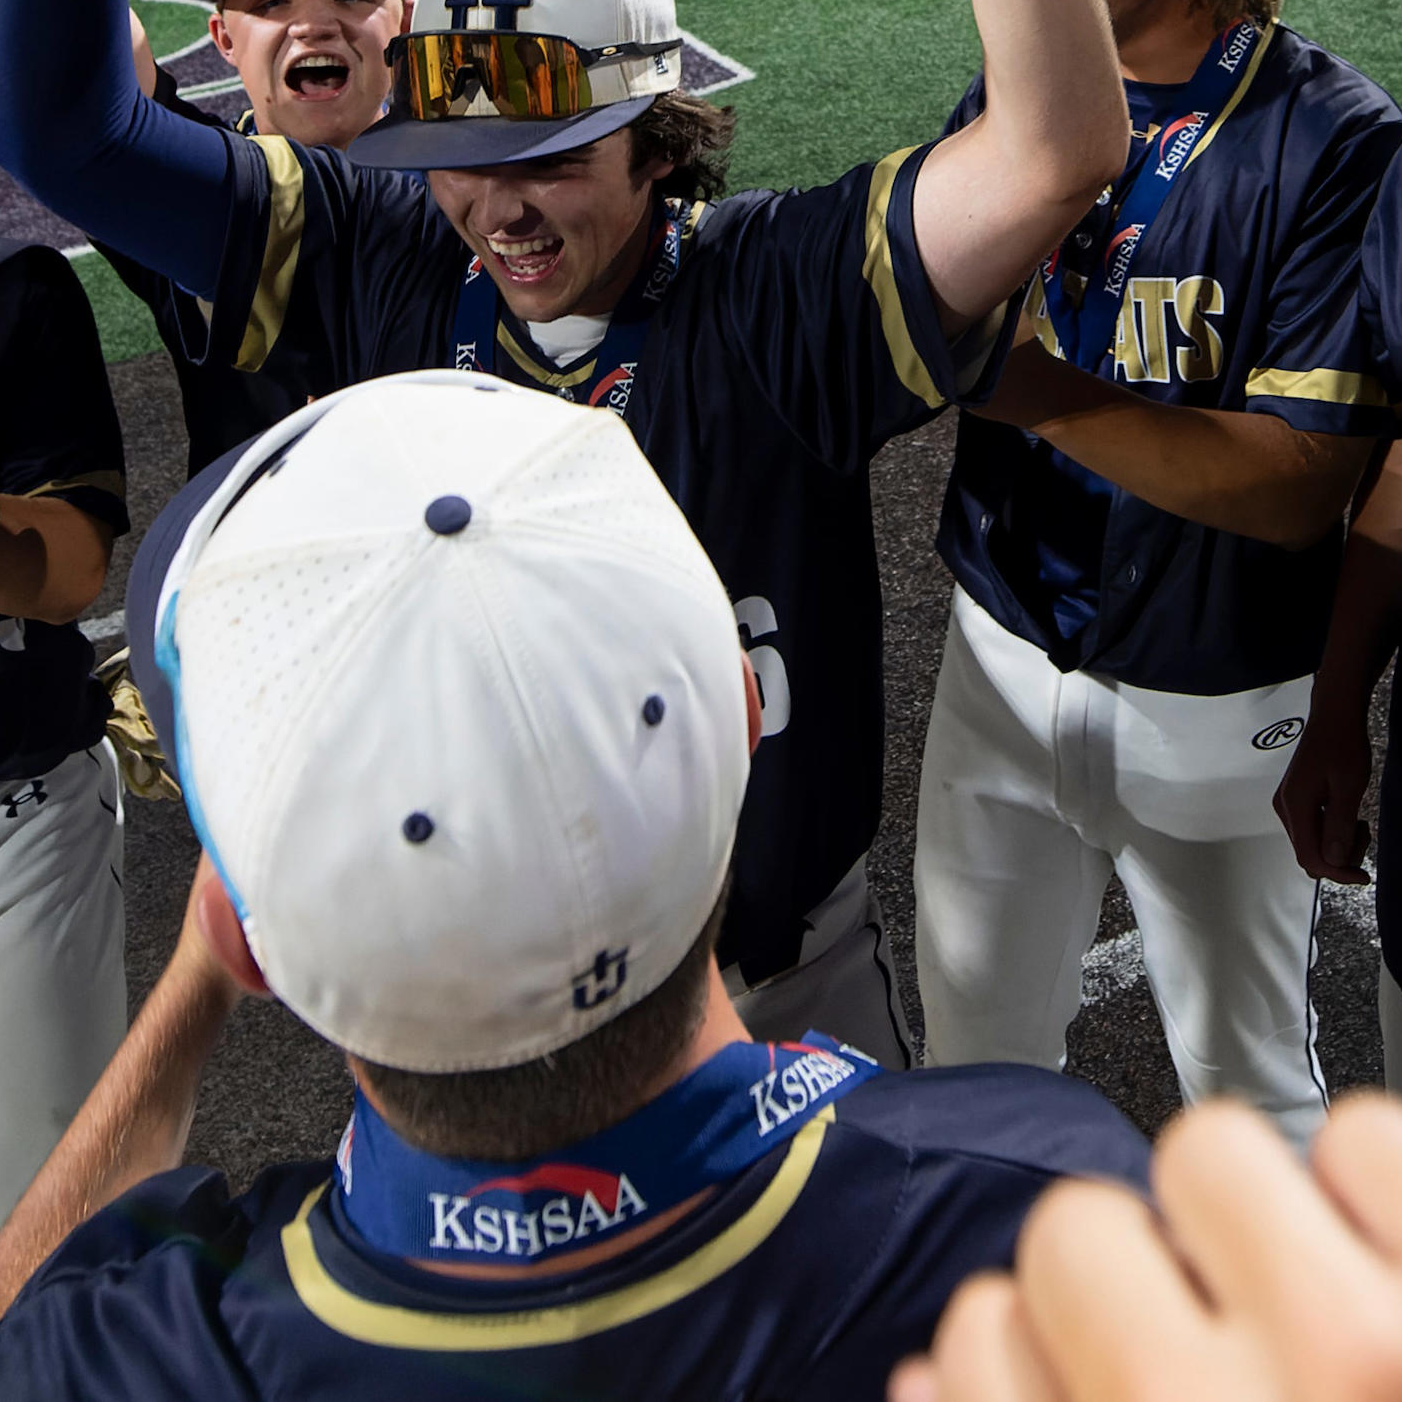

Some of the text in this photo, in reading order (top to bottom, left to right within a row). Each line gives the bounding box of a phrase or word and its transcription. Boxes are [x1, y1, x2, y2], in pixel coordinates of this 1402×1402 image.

[1155, 110, 1209, 182] KSHSAA
[1104, 223, 1146, 298] KSHSAA
[428, 1172, 648, 1256] KSHSAA
